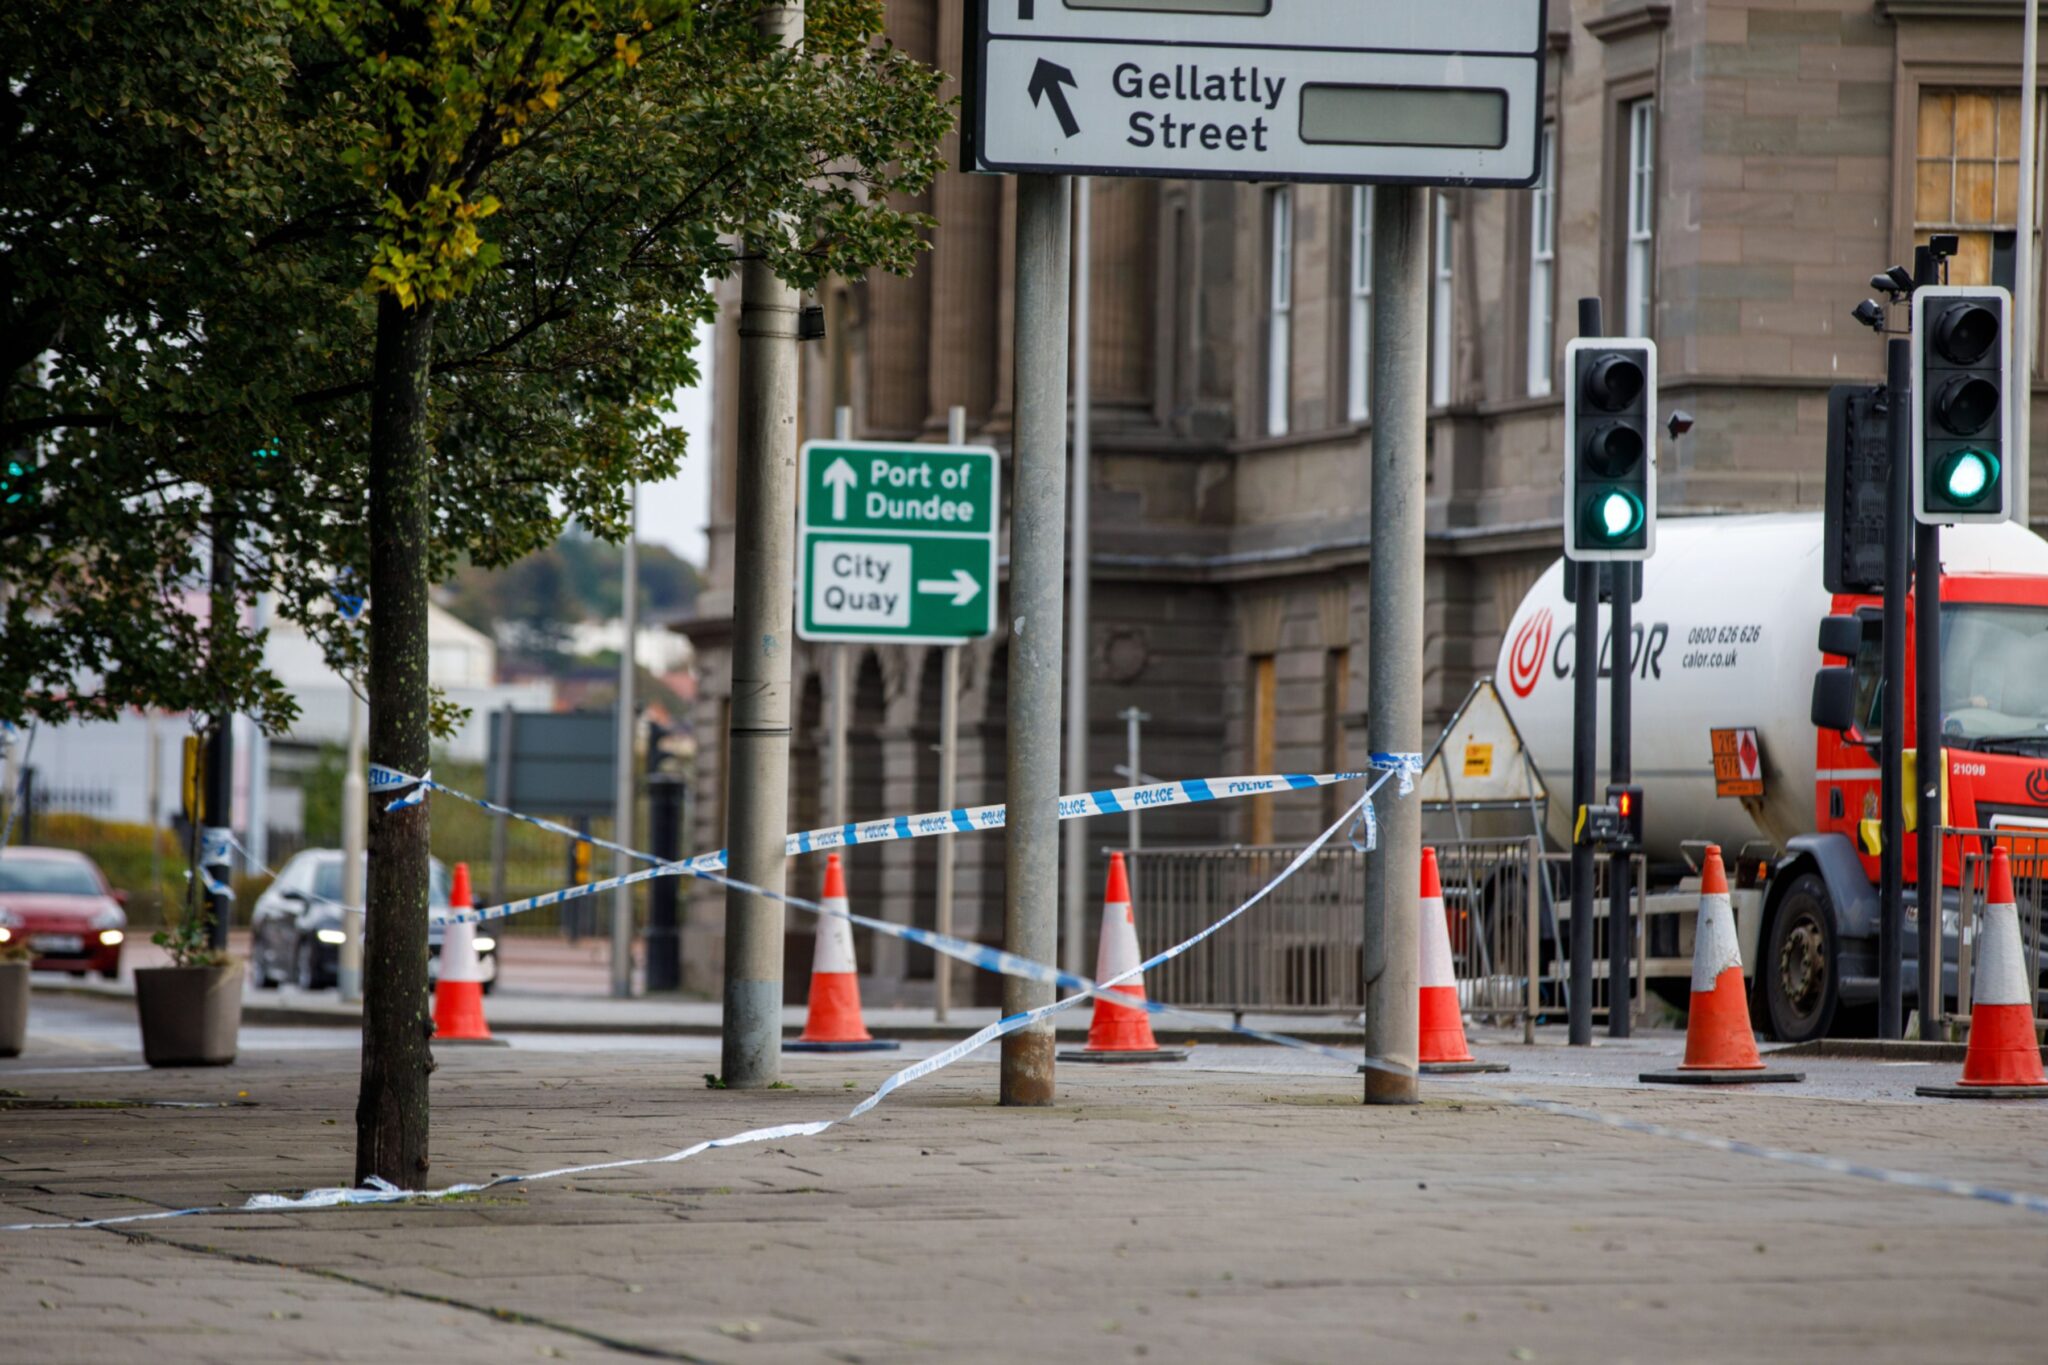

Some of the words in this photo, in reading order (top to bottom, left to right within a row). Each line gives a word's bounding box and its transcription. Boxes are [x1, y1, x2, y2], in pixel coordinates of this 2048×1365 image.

[1112, 62, 1286, 110] Gellatly
[1126, 111, 1268, 152] Street
[870, 460, 932, 488] Port
[940, 463, 972, 489] of
[866, 492, 974, 522] Dundee
[833, 554, 890, 582] City
[824, 586, 898, 616] Quay
[1688, 626, 1717, 645] 0800
[1718, 625, 1739, 644] 626
[1740, 625, 1761, 643] 626
[1553, 622, 1669, 679] CLR
[1682, 648, 1738, 669] calor.co.uk
[1953, 763, 1986, 776] 21098
[919, 815, 947, 833] POLICE
[980, 808, 1006, 826] POLIC
[1133, 787, 1174, 806] POLICE
